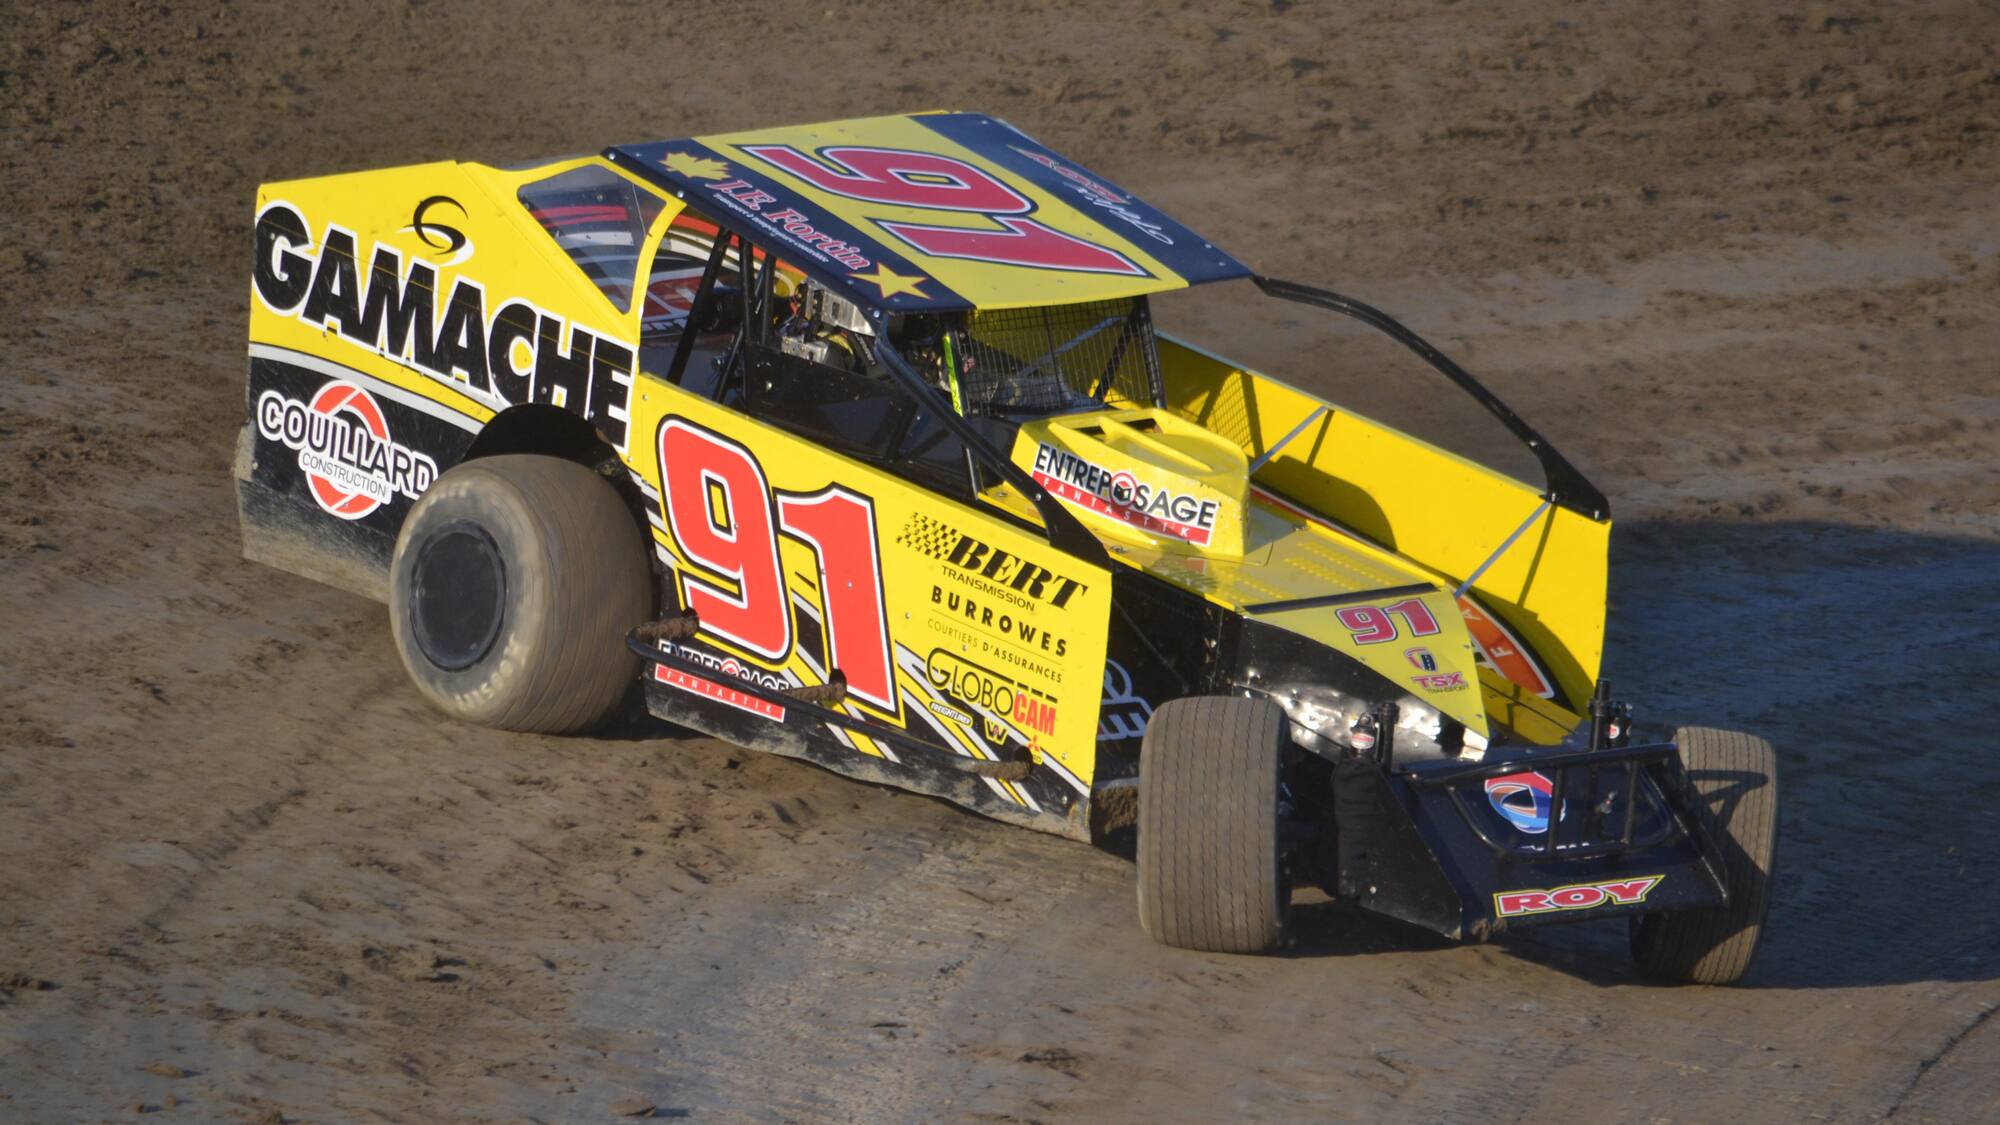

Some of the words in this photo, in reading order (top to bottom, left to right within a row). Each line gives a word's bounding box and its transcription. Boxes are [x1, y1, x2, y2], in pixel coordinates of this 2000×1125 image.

[727, 144, 1159, 280] 91
[762, 208, 871, 270] Fortin
[252, 202, 634, 454] GAMACHE
[259, 391, 438, 499] COUILLARD
[302, 452, 387, 497] CONSTRUCTION
[1044, 477, 1189, 538] FANTASTIK
[657, 415, 901, 718] 91
[942, 565, 1035, 612] TRANSMISSION
[944, 534, 1088, 611] BERT
[927, 618, 978, 648] COURTIERS
[982, 642, 1062, 683] D'ASSURANCES
[931, 584, 1067, 657] BURROWES
[1335, 598, 1440, 645] 91
[666, 670, 772, 713] FANTASTIK
[1411, 672, 1463, 688] TSX
[1497, 876, 1660, 916] ROY
